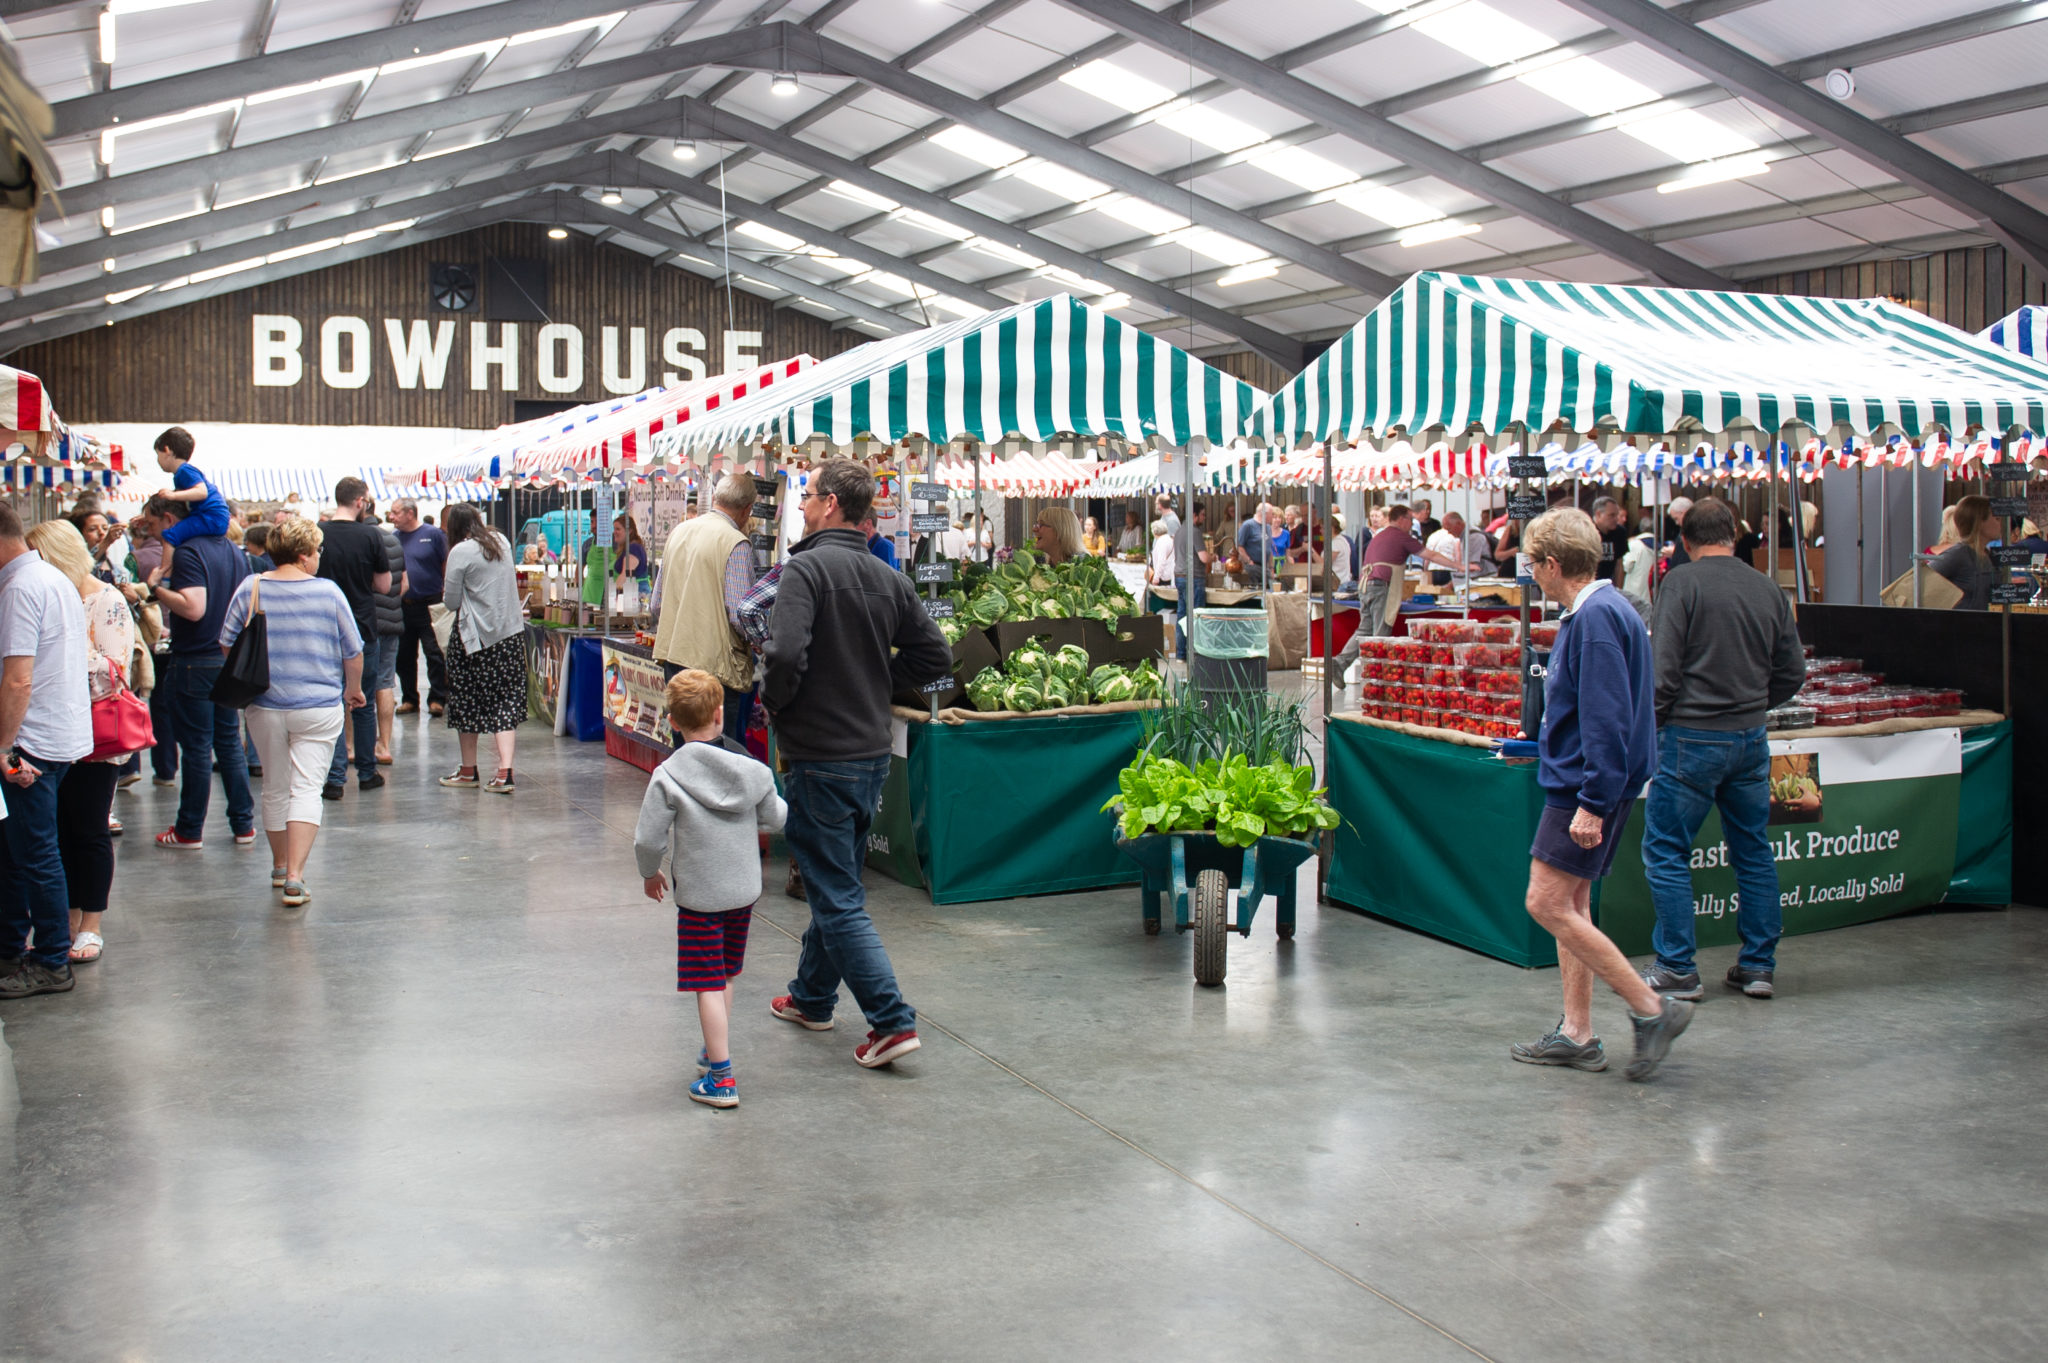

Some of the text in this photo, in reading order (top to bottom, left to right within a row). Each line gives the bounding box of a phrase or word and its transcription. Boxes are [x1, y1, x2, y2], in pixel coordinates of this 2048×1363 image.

[252, 314, 762, 394] BOWHOUSE
[633, 488, 653, 503] Natura
[666, 484, 686, 501] Drinks
[1689, 825, 1900, 869] ast uk Produce
[1692, 893, 1725, 919] ally
[1808, 878, 1867, 903] Locally
[1869, 872, 1905, 896] Sold
